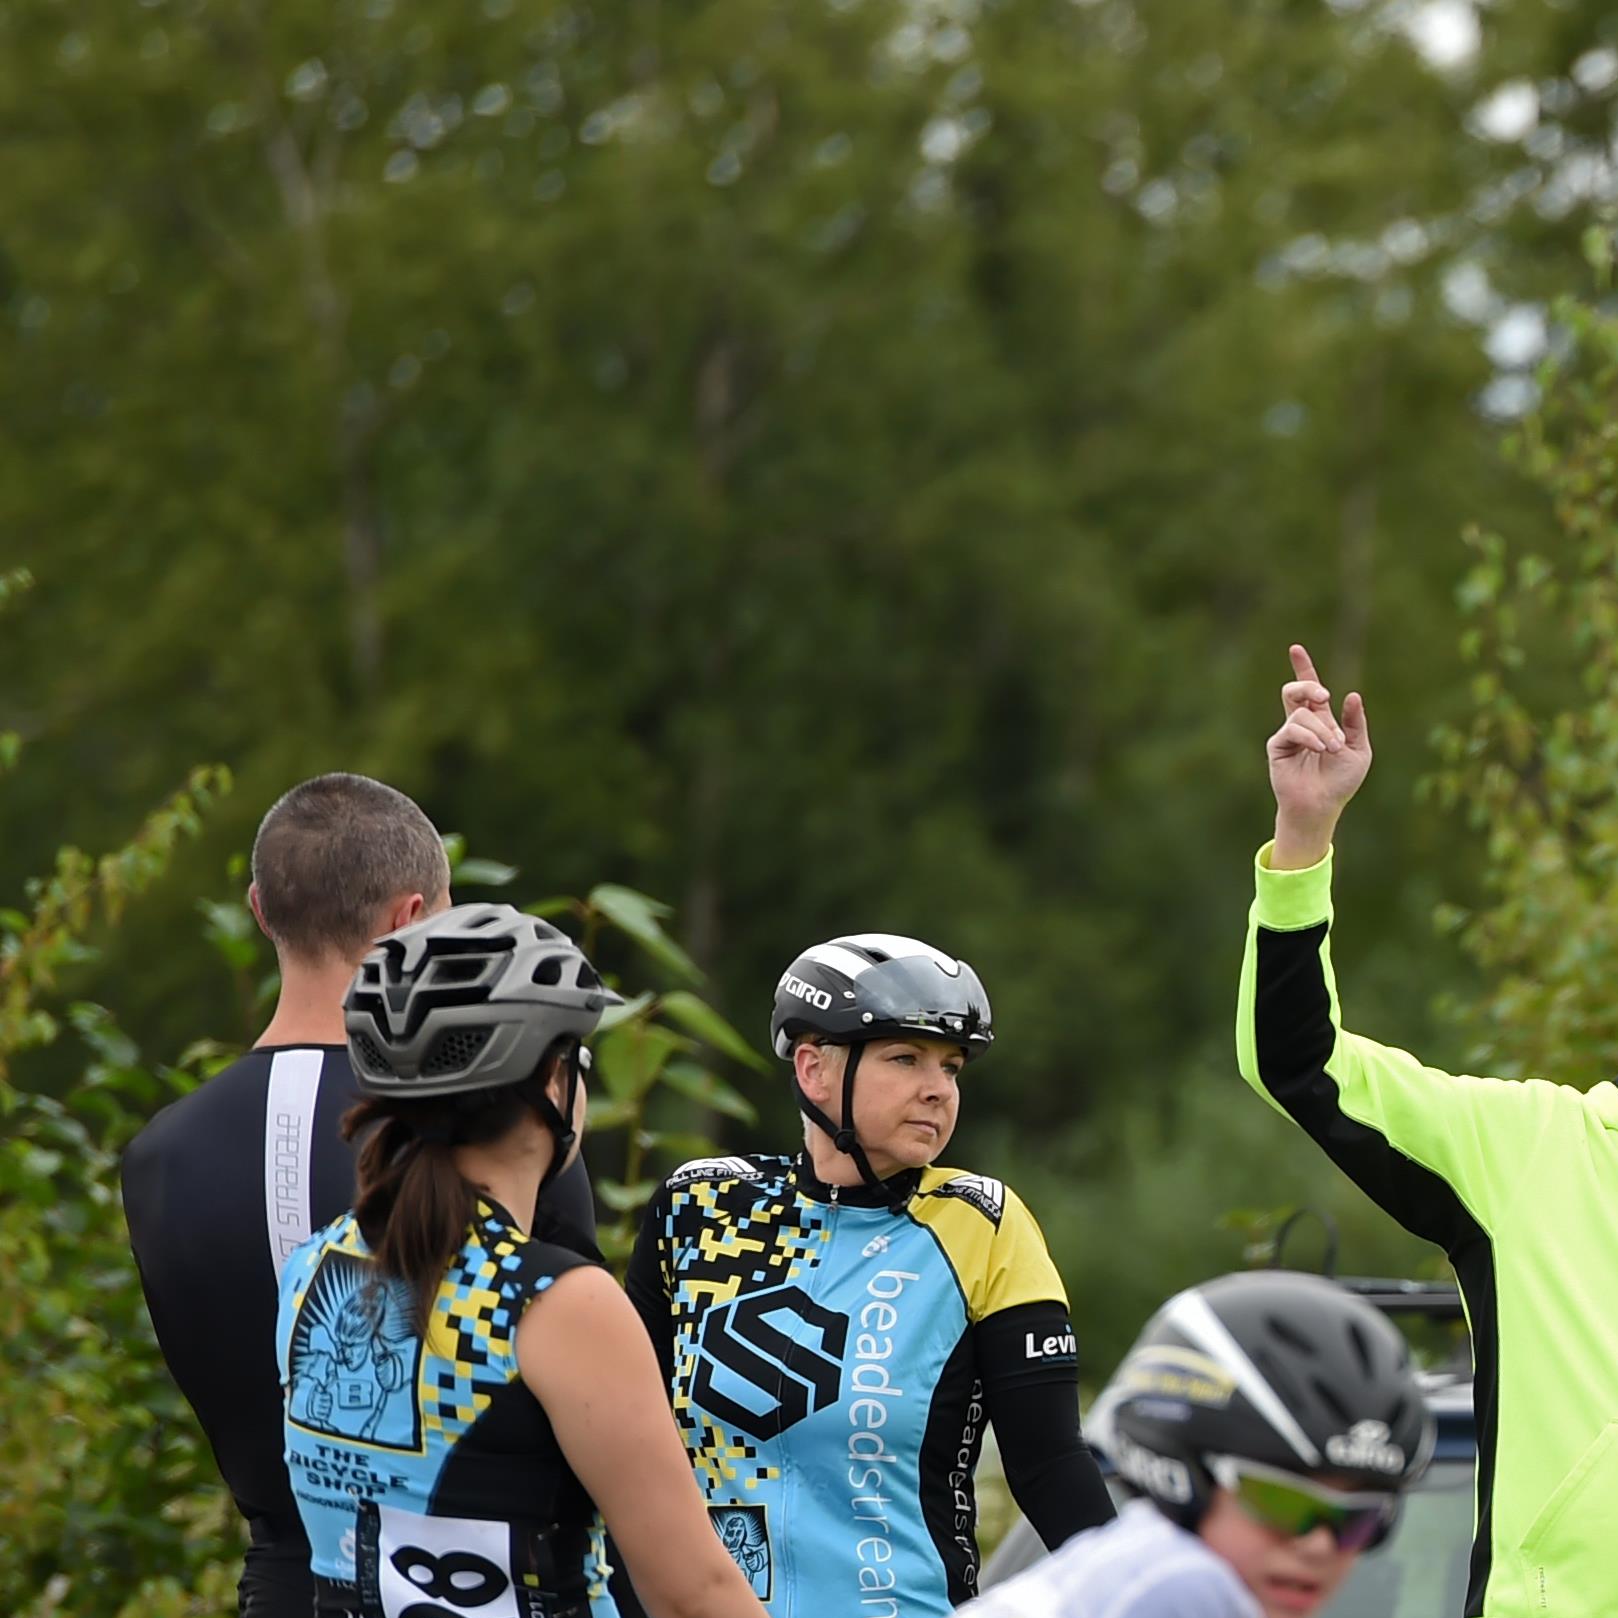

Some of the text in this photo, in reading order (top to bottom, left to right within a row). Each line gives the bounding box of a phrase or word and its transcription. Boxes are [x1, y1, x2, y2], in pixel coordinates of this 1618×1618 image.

[785, 975, 832, 1011] GIRO
[315, 1443, 370, 1467] THE
[306, 1471, 387, 1497] SHOP
